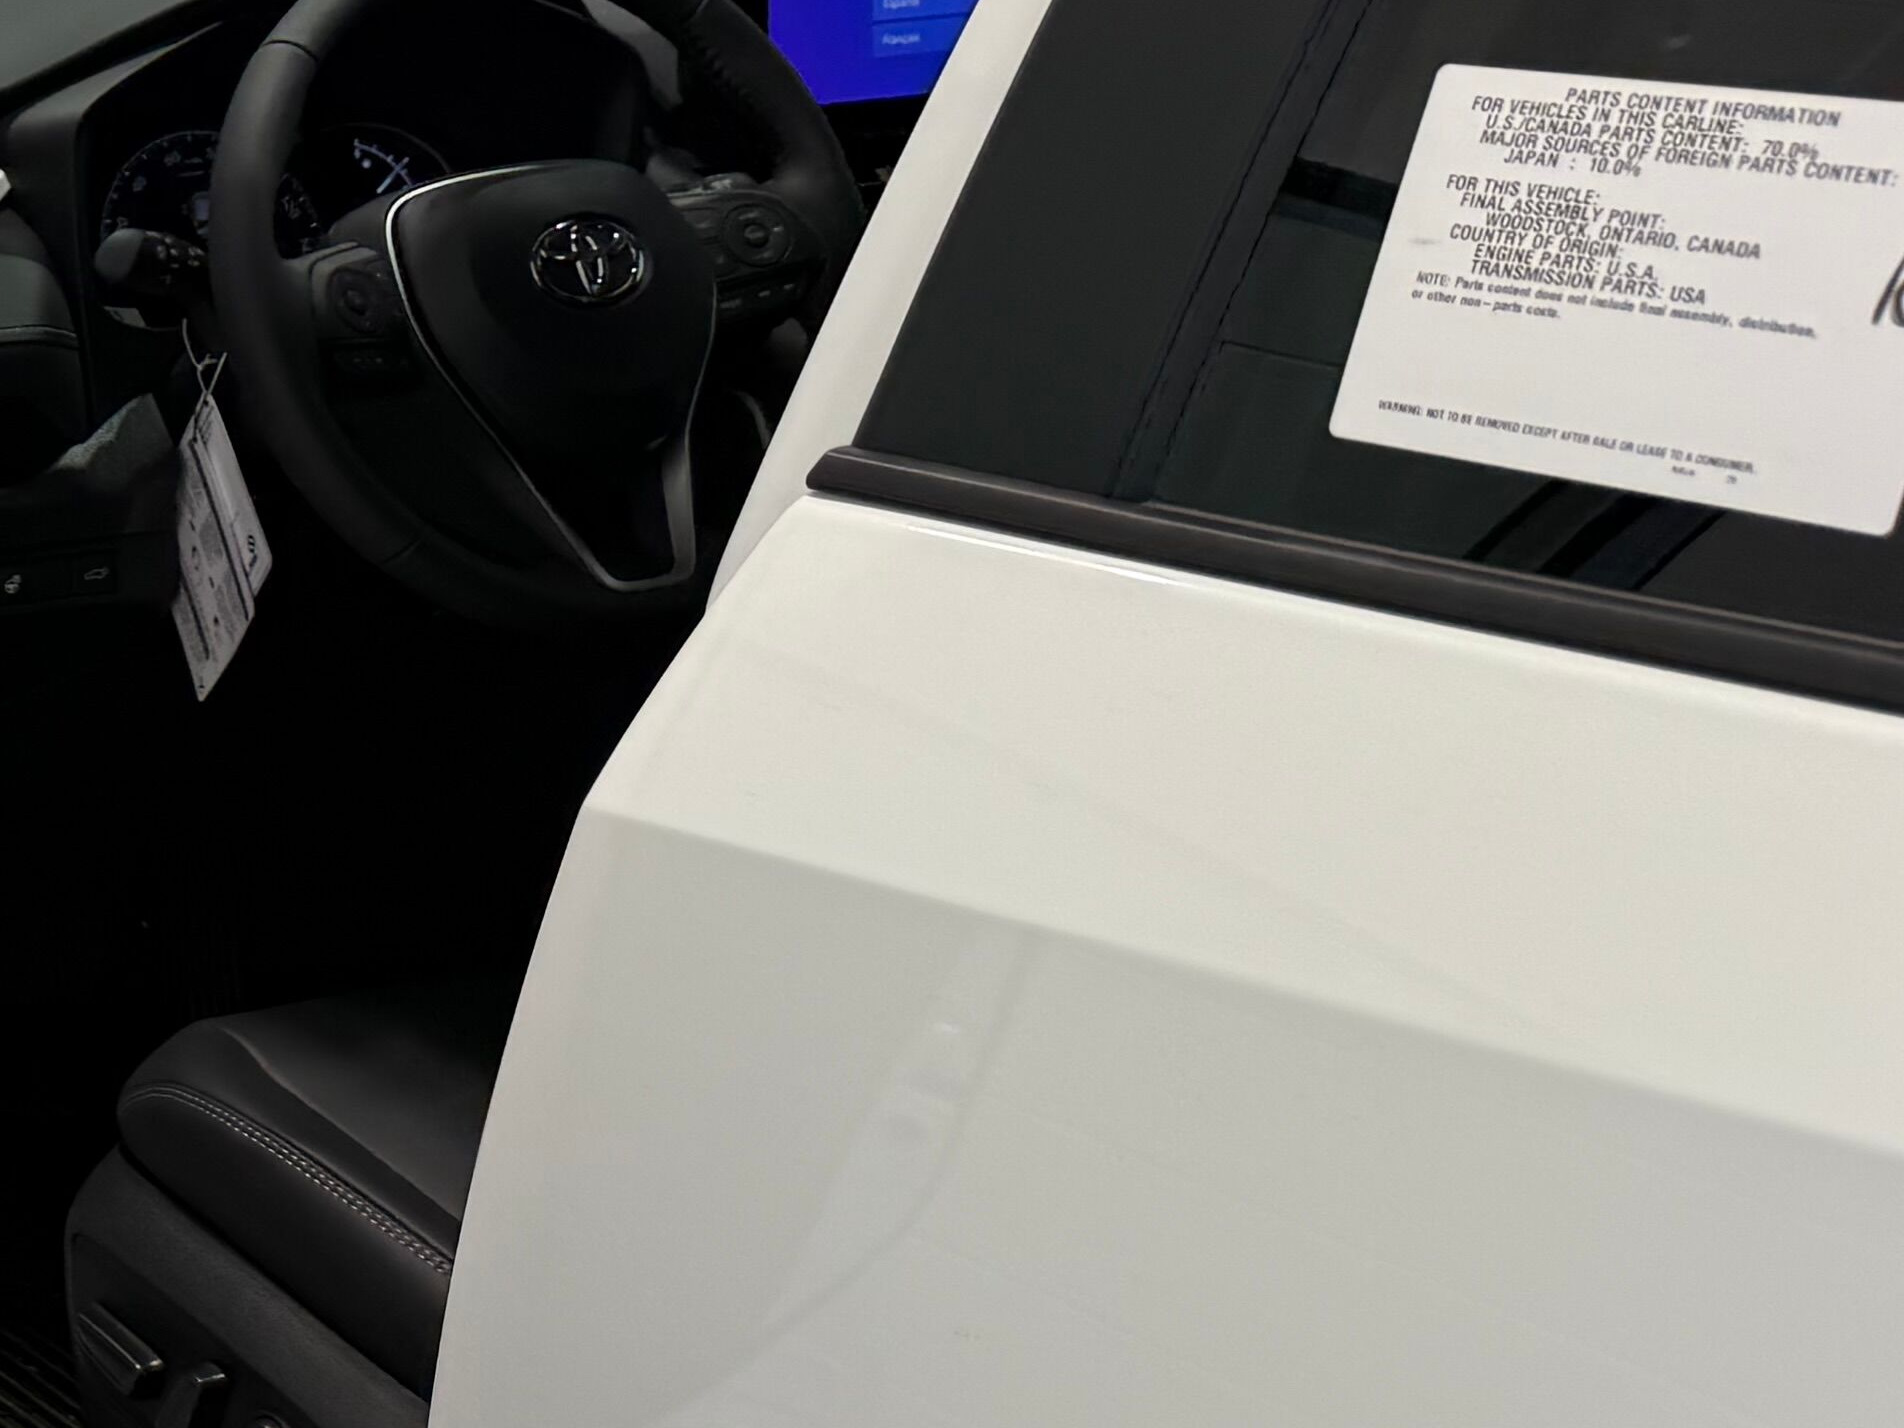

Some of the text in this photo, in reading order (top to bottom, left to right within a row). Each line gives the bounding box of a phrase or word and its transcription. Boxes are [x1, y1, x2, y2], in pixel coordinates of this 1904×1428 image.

[1472, 95, 1744, 136] FOR VEHICLES IN THIS CARLINE:
[1565, 88, 1842, 127] PARTS CONTENT INFORMATION
[1486, 114, 1820, 161] U.S./CANADA PARTS CONTENT: 70.0%
[1479, 130, 1899, 188] MAJOR SOURCES OF FOREIGN PARTS CONTENT:
[1504, 149, 1560, 169] JAPAN
[1591, 158, 1642, 178] 10.0%
[1447, 174, 1600, 205] FOR THIS VEHICLE:
[1460, 192, 1666, 229] FINAL ASSEMBLY POINT:
[1450, 223, 1624, 259] COUNTRY OF ORIGIN:
[1486, 212, 1761, 259] WOODSTOCK, ONTARIO, CANADA
[1474, 243, 1658, 280] ENGINE PARTS: U.S.A.
[1411, 288, 1423, 300] or
[1427, 290, 1457, 304] other
[1416, 271, 1451, 288] NOTE:
[1454, 276, 1484, 292] Parts
[1487, 282, 1532, 298] content
[1567, 291, 1587, 305] not
[1471, 259, 1706, 304] TRANSMISSION PARTS: USA
